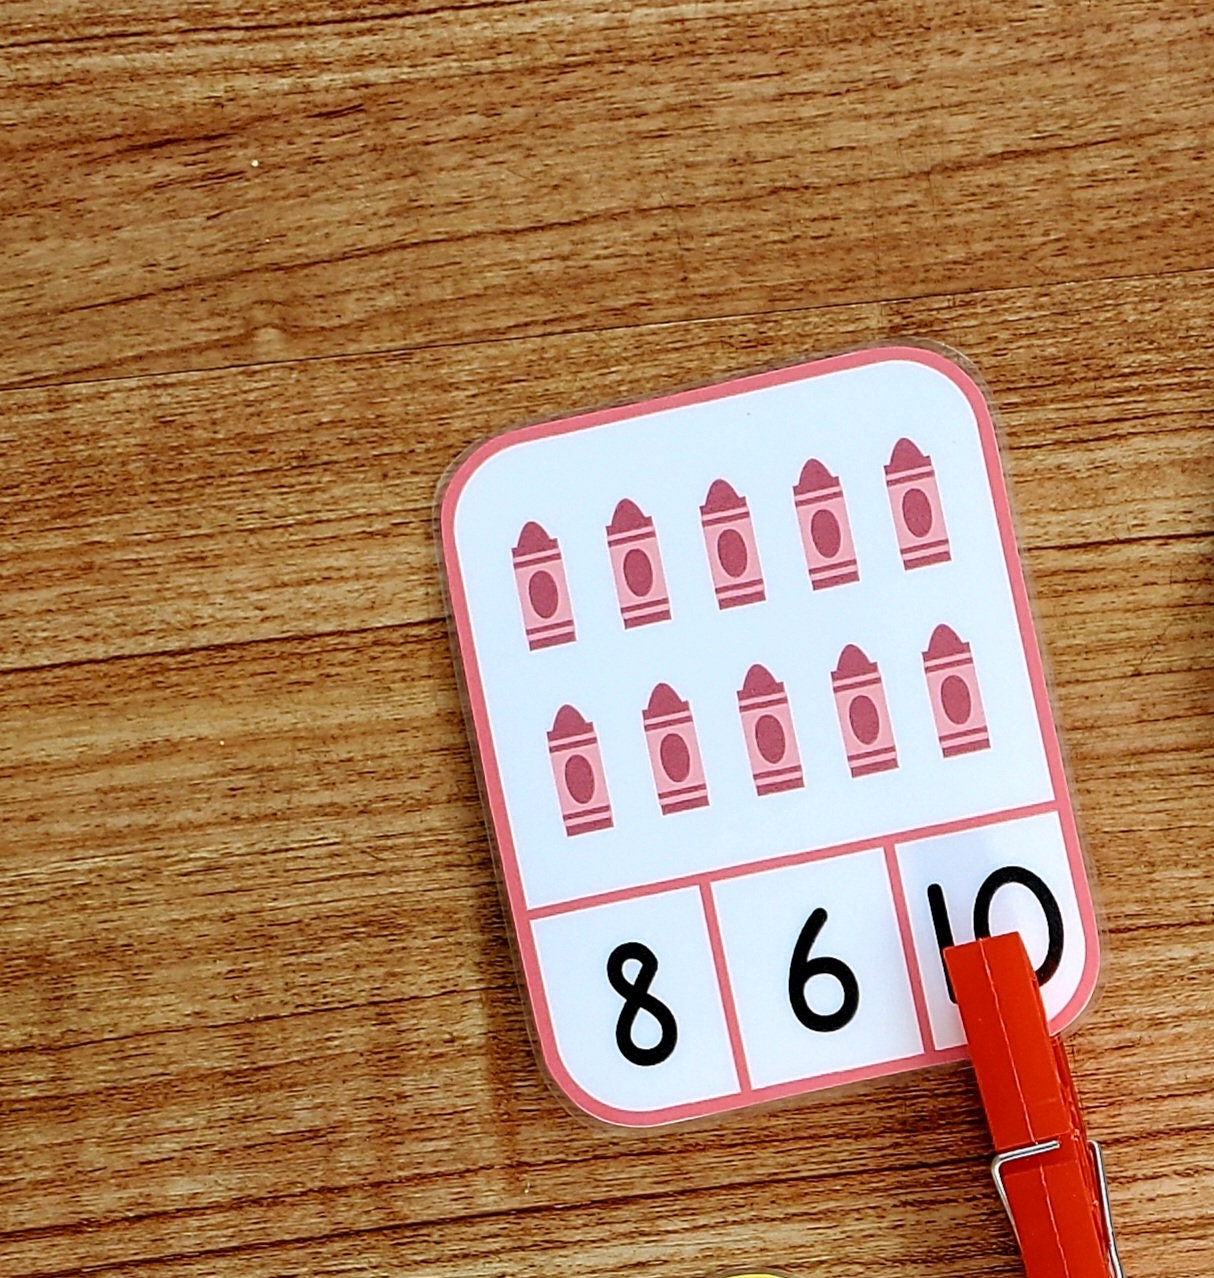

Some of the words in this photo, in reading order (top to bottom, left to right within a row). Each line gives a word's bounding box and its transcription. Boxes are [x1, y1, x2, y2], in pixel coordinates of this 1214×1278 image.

[606, 942, 678, 1067] 8
[788, 907, 860, 1033] 6
[927, 866, 1064, 1004] 10
